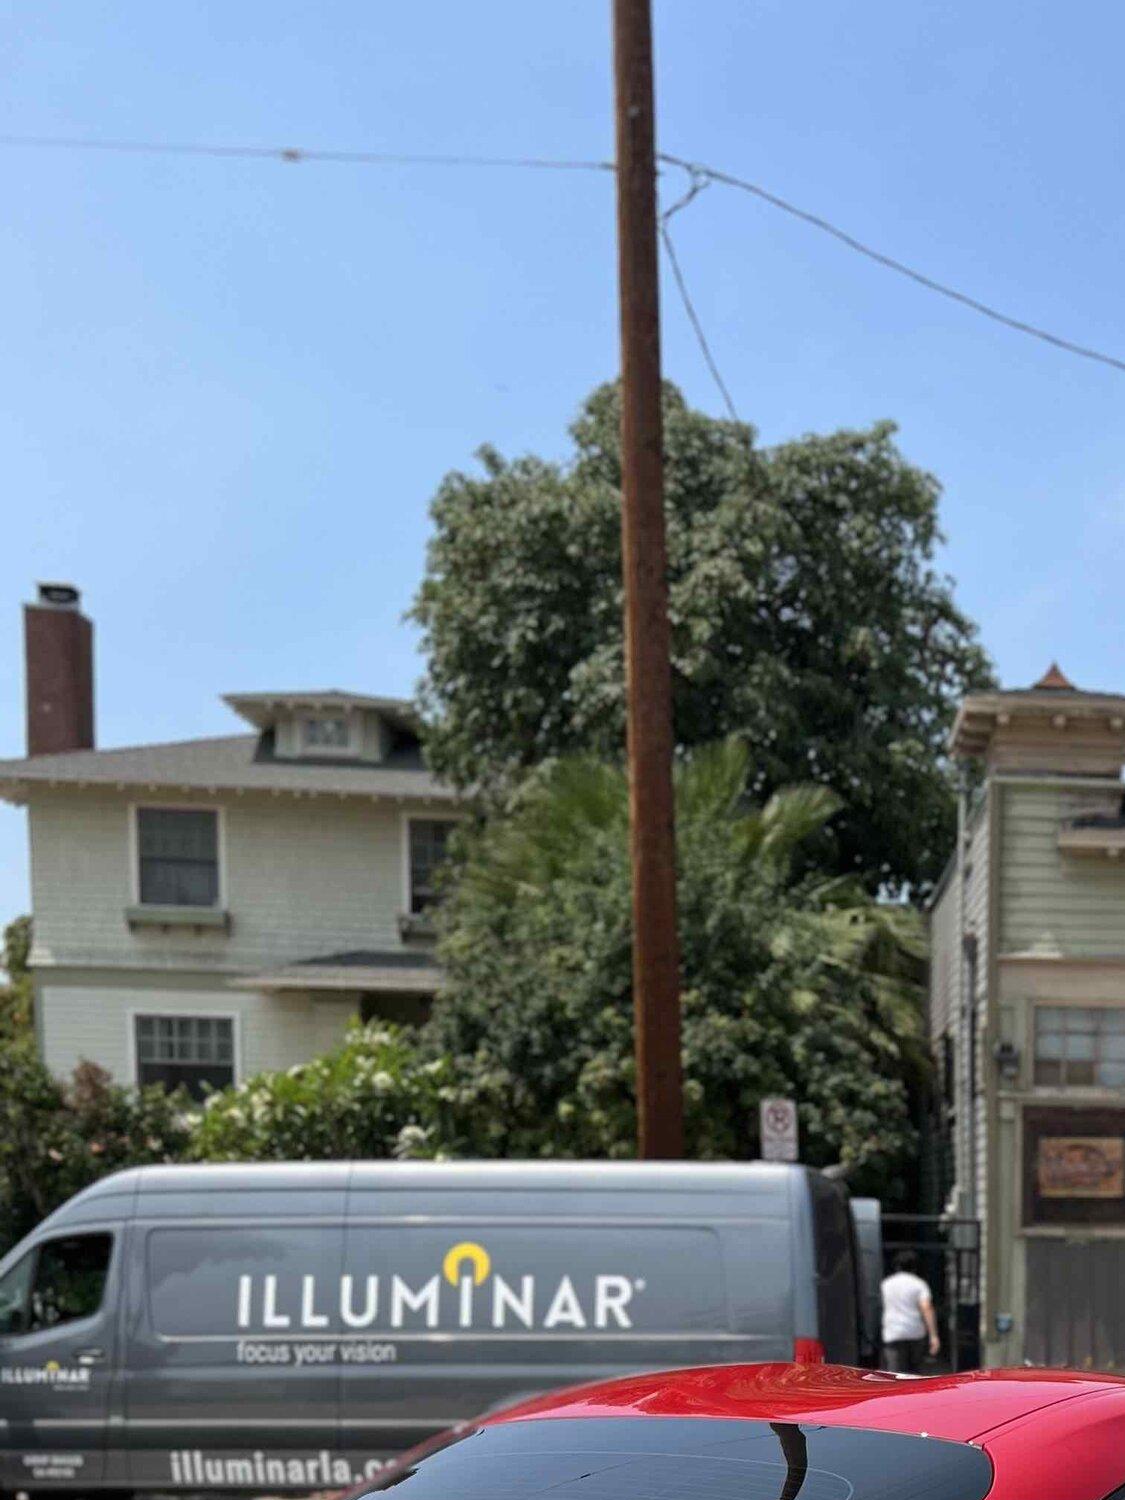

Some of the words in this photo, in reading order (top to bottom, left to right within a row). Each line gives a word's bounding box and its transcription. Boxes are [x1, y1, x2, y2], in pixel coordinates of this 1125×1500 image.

[237, 1341, 289, 1362] focus
[293, 1346, 337, 1367] your
[340, 1341, 397, 1362] vision
